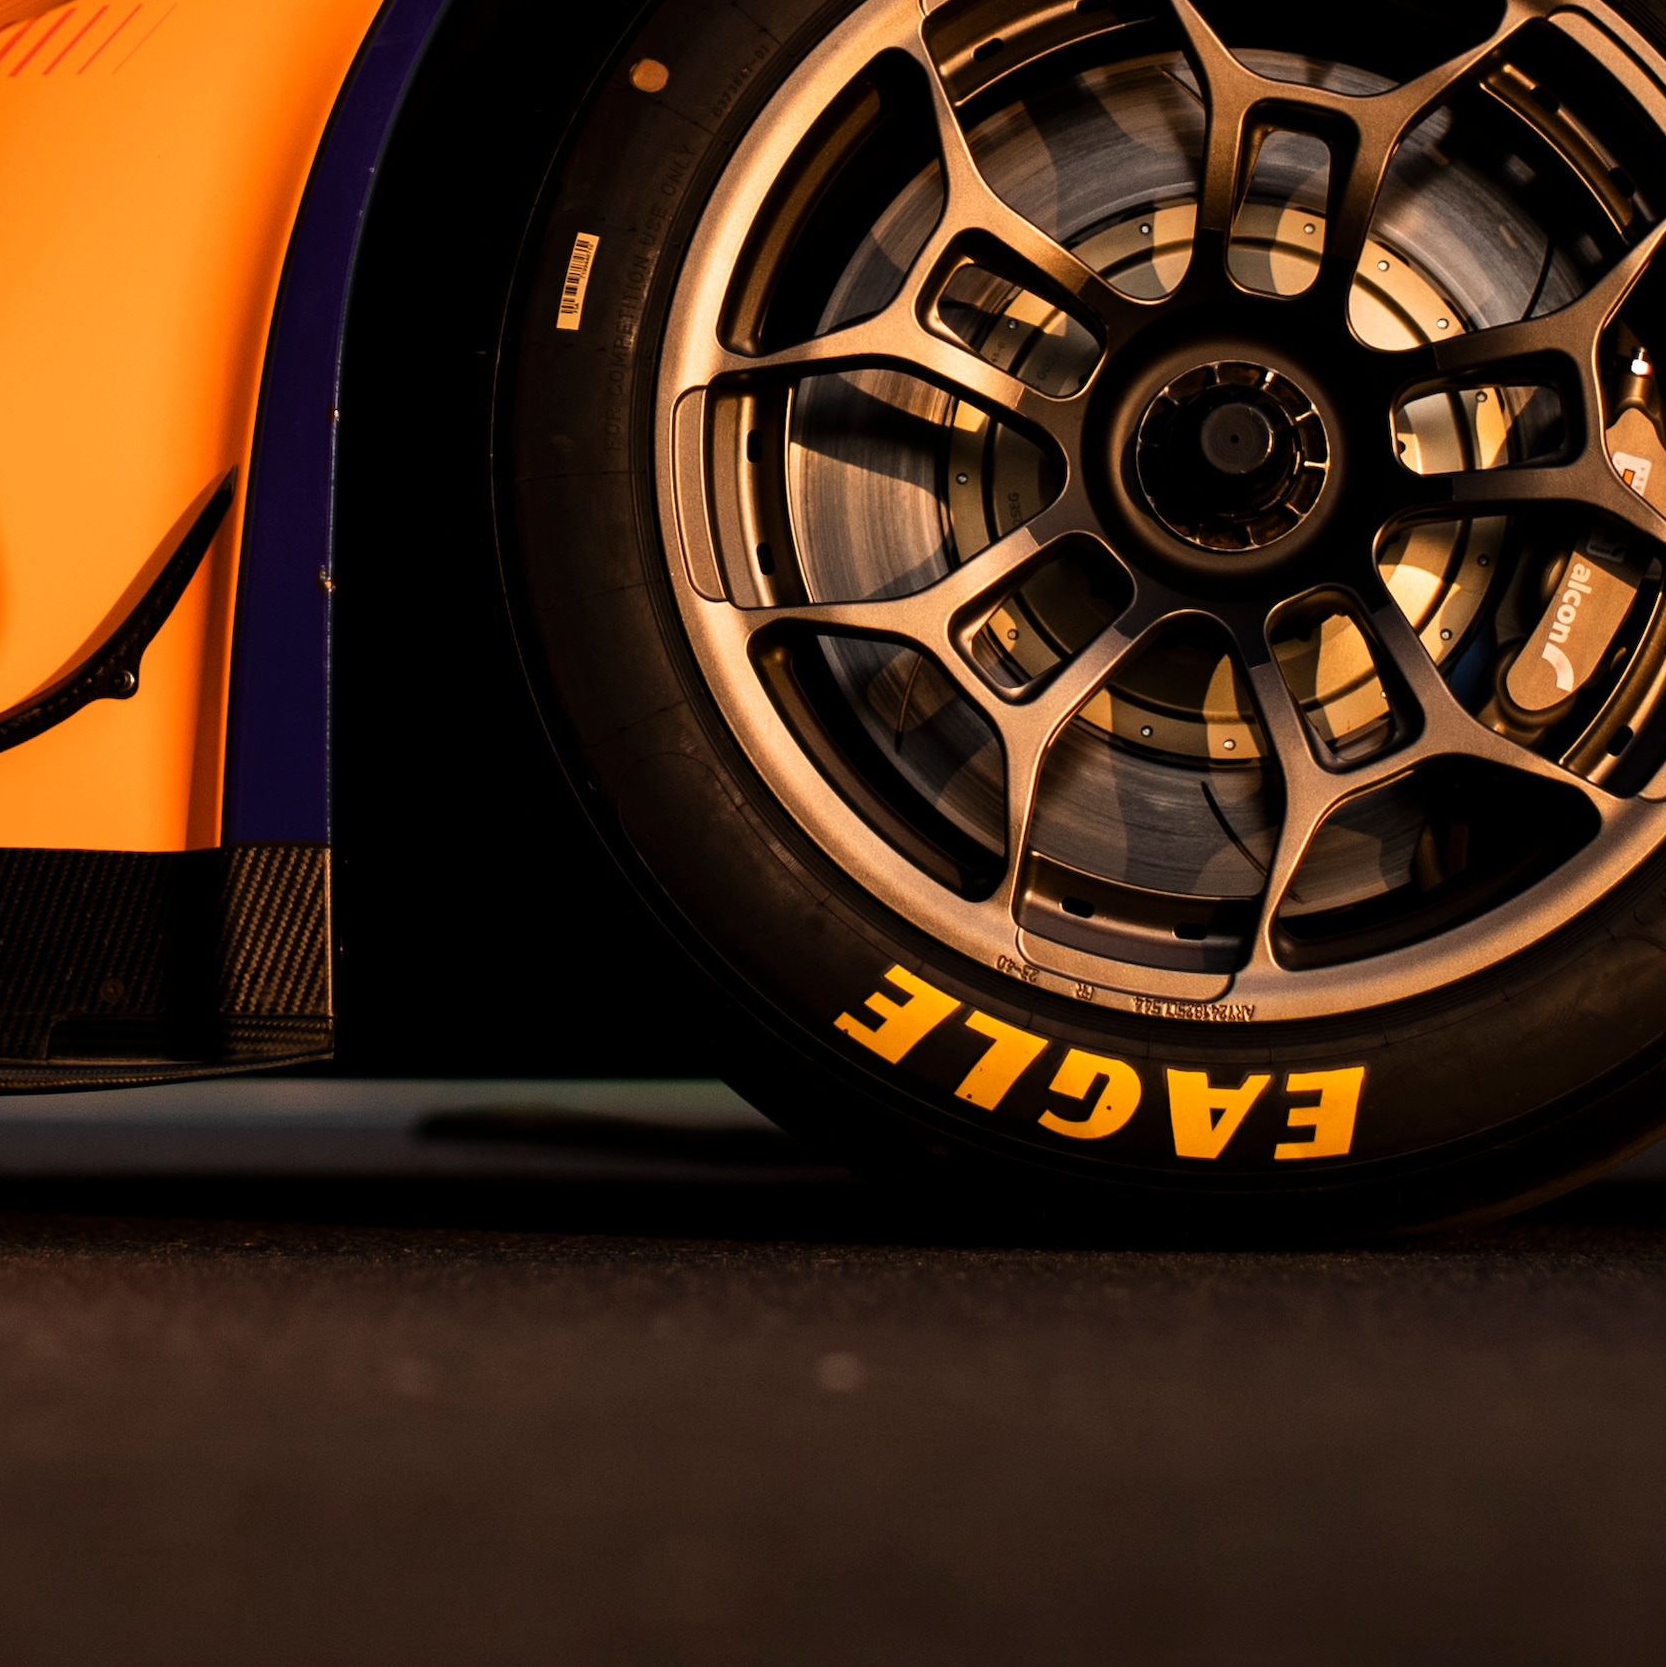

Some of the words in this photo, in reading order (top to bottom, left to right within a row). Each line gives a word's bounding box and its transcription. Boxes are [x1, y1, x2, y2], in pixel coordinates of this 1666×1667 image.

[659, 143, 696, 198] ONLY
[639, 205, 669, 248] USE
[608, 252, 652, 397] COMPETITION
[603, 407, 622, 452] FOR
[1547, 562, 1593, 643] alcon
[834, 964, 1365, 1159] EAGLE
